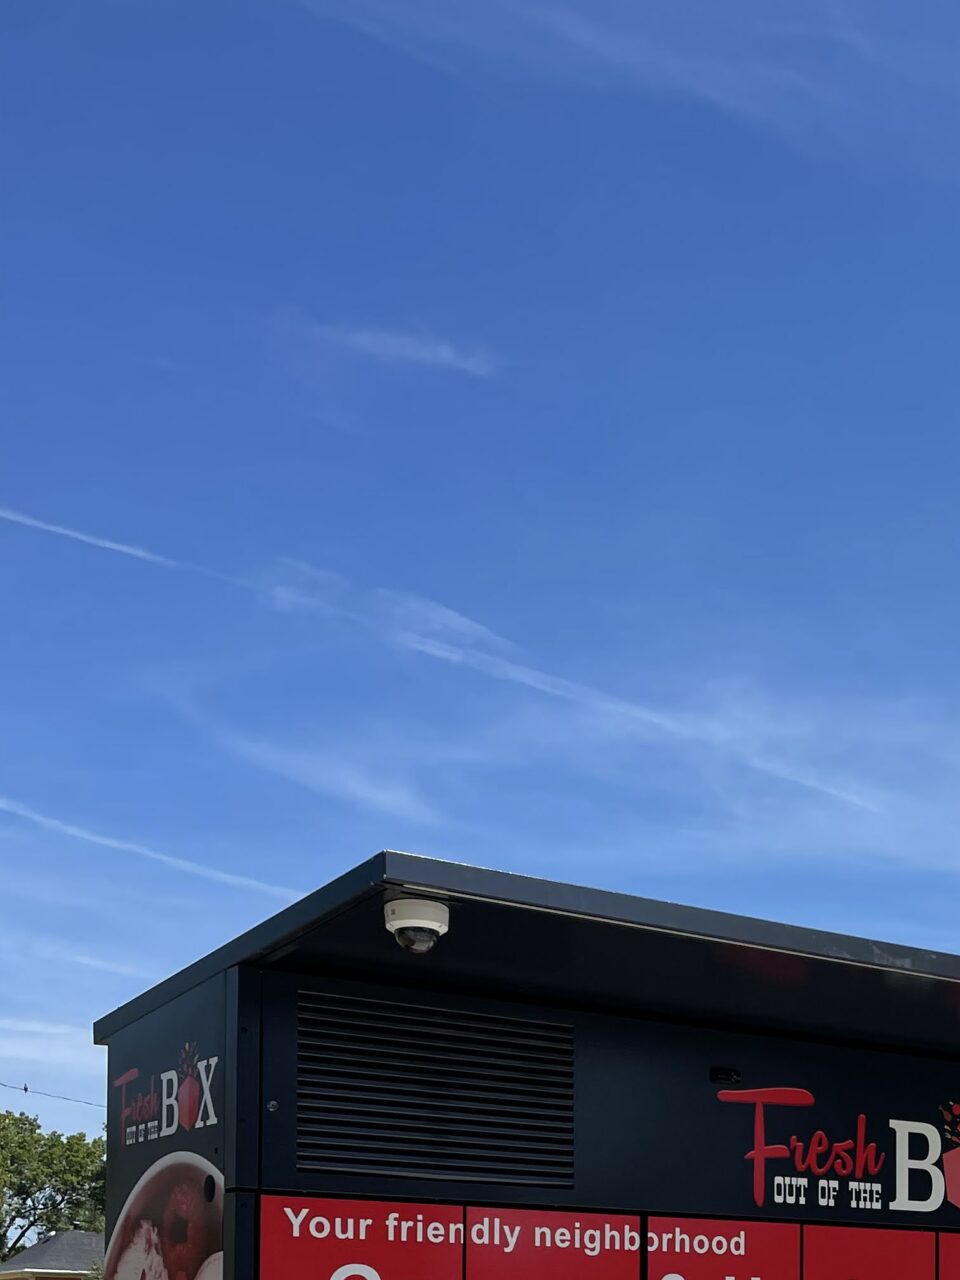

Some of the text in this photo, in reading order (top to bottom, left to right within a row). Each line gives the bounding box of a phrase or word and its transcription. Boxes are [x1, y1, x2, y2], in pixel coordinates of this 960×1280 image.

[716, 1087, 886, 1208] Fresh
[774, 1176, 882, 1210] OUT OF THE
[284, 1207, 746, 1256] Your friendly neighborhood
